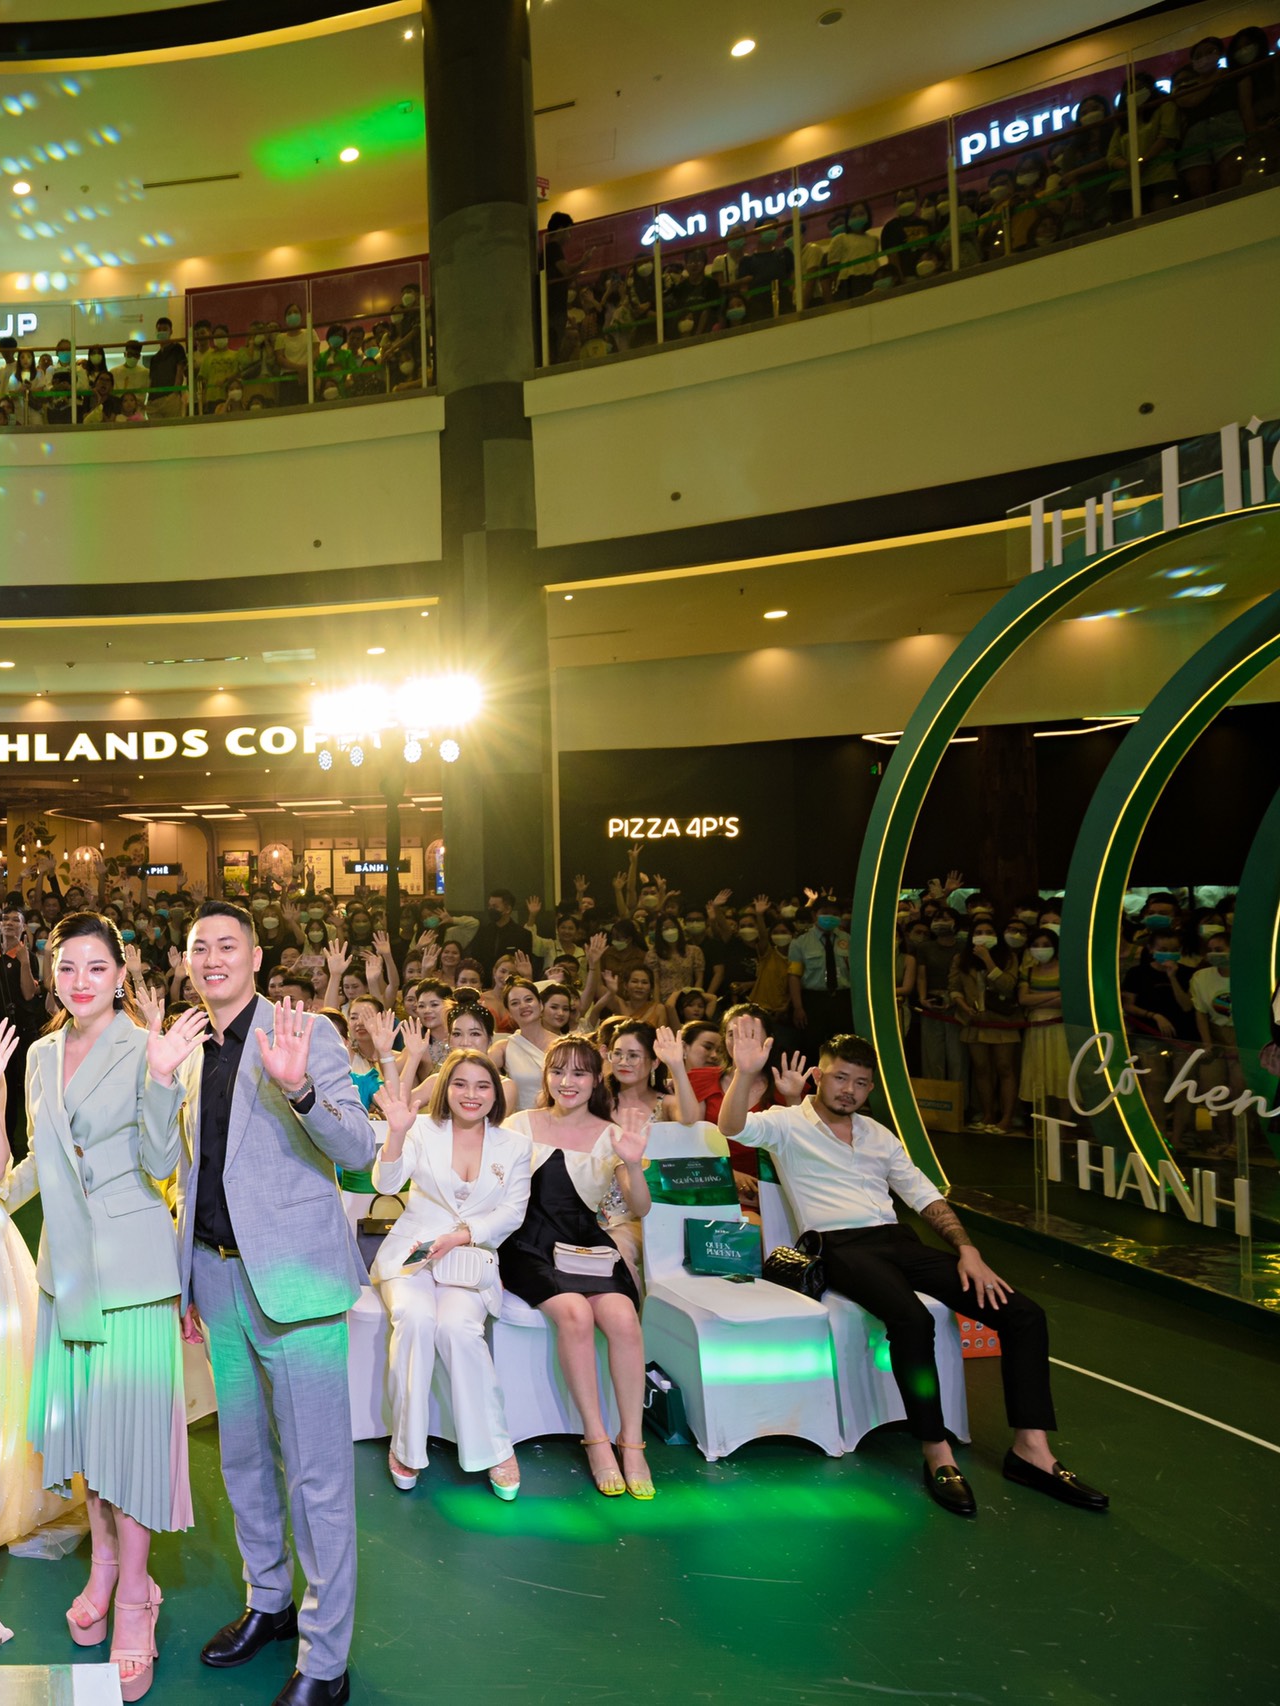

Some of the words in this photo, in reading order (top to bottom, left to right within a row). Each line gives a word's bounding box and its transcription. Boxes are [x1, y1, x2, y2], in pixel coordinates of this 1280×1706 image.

[1006, 478, 1145, 574] THE
[225, 725, 360, 756] COF
[608, 817, 681, 839] PIZZA
[686, 816, 739, 839] 4P'S
[354, 862, 384, 873] BÁNH
[1030, 1113, 1251, 1237] THANH
